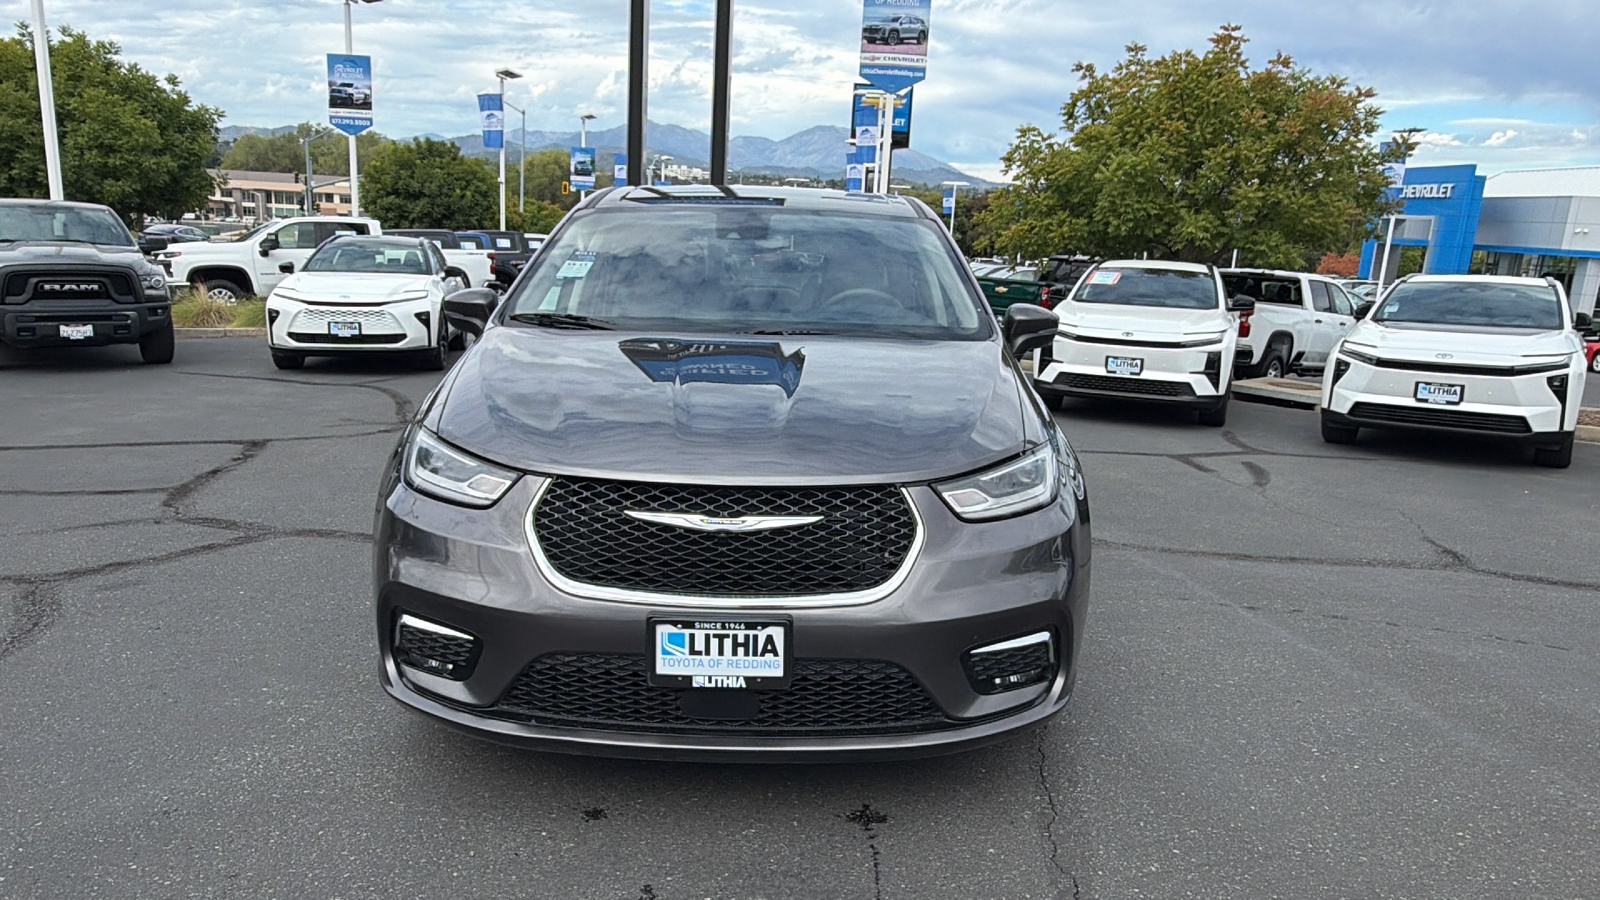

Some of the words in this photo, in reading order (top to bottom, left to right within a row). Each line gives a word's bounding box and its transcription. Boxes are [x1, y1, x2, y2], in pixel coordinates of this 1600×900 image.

[883, 55, 925, 63] CHEVROLET
[1428, 387, 1458, 396] LITHIA
[694, 622, 722, 630] SINCE
[724, 622, 745, 630] 1946
[688, 632, 780, 657] LITHIA
[661, 657, 705, 668] TOYOTA
[708, 658, 724, 669] OF
[726, 658, 780, 669] REDDING
[704, 675, 747, 688] LITHIA
